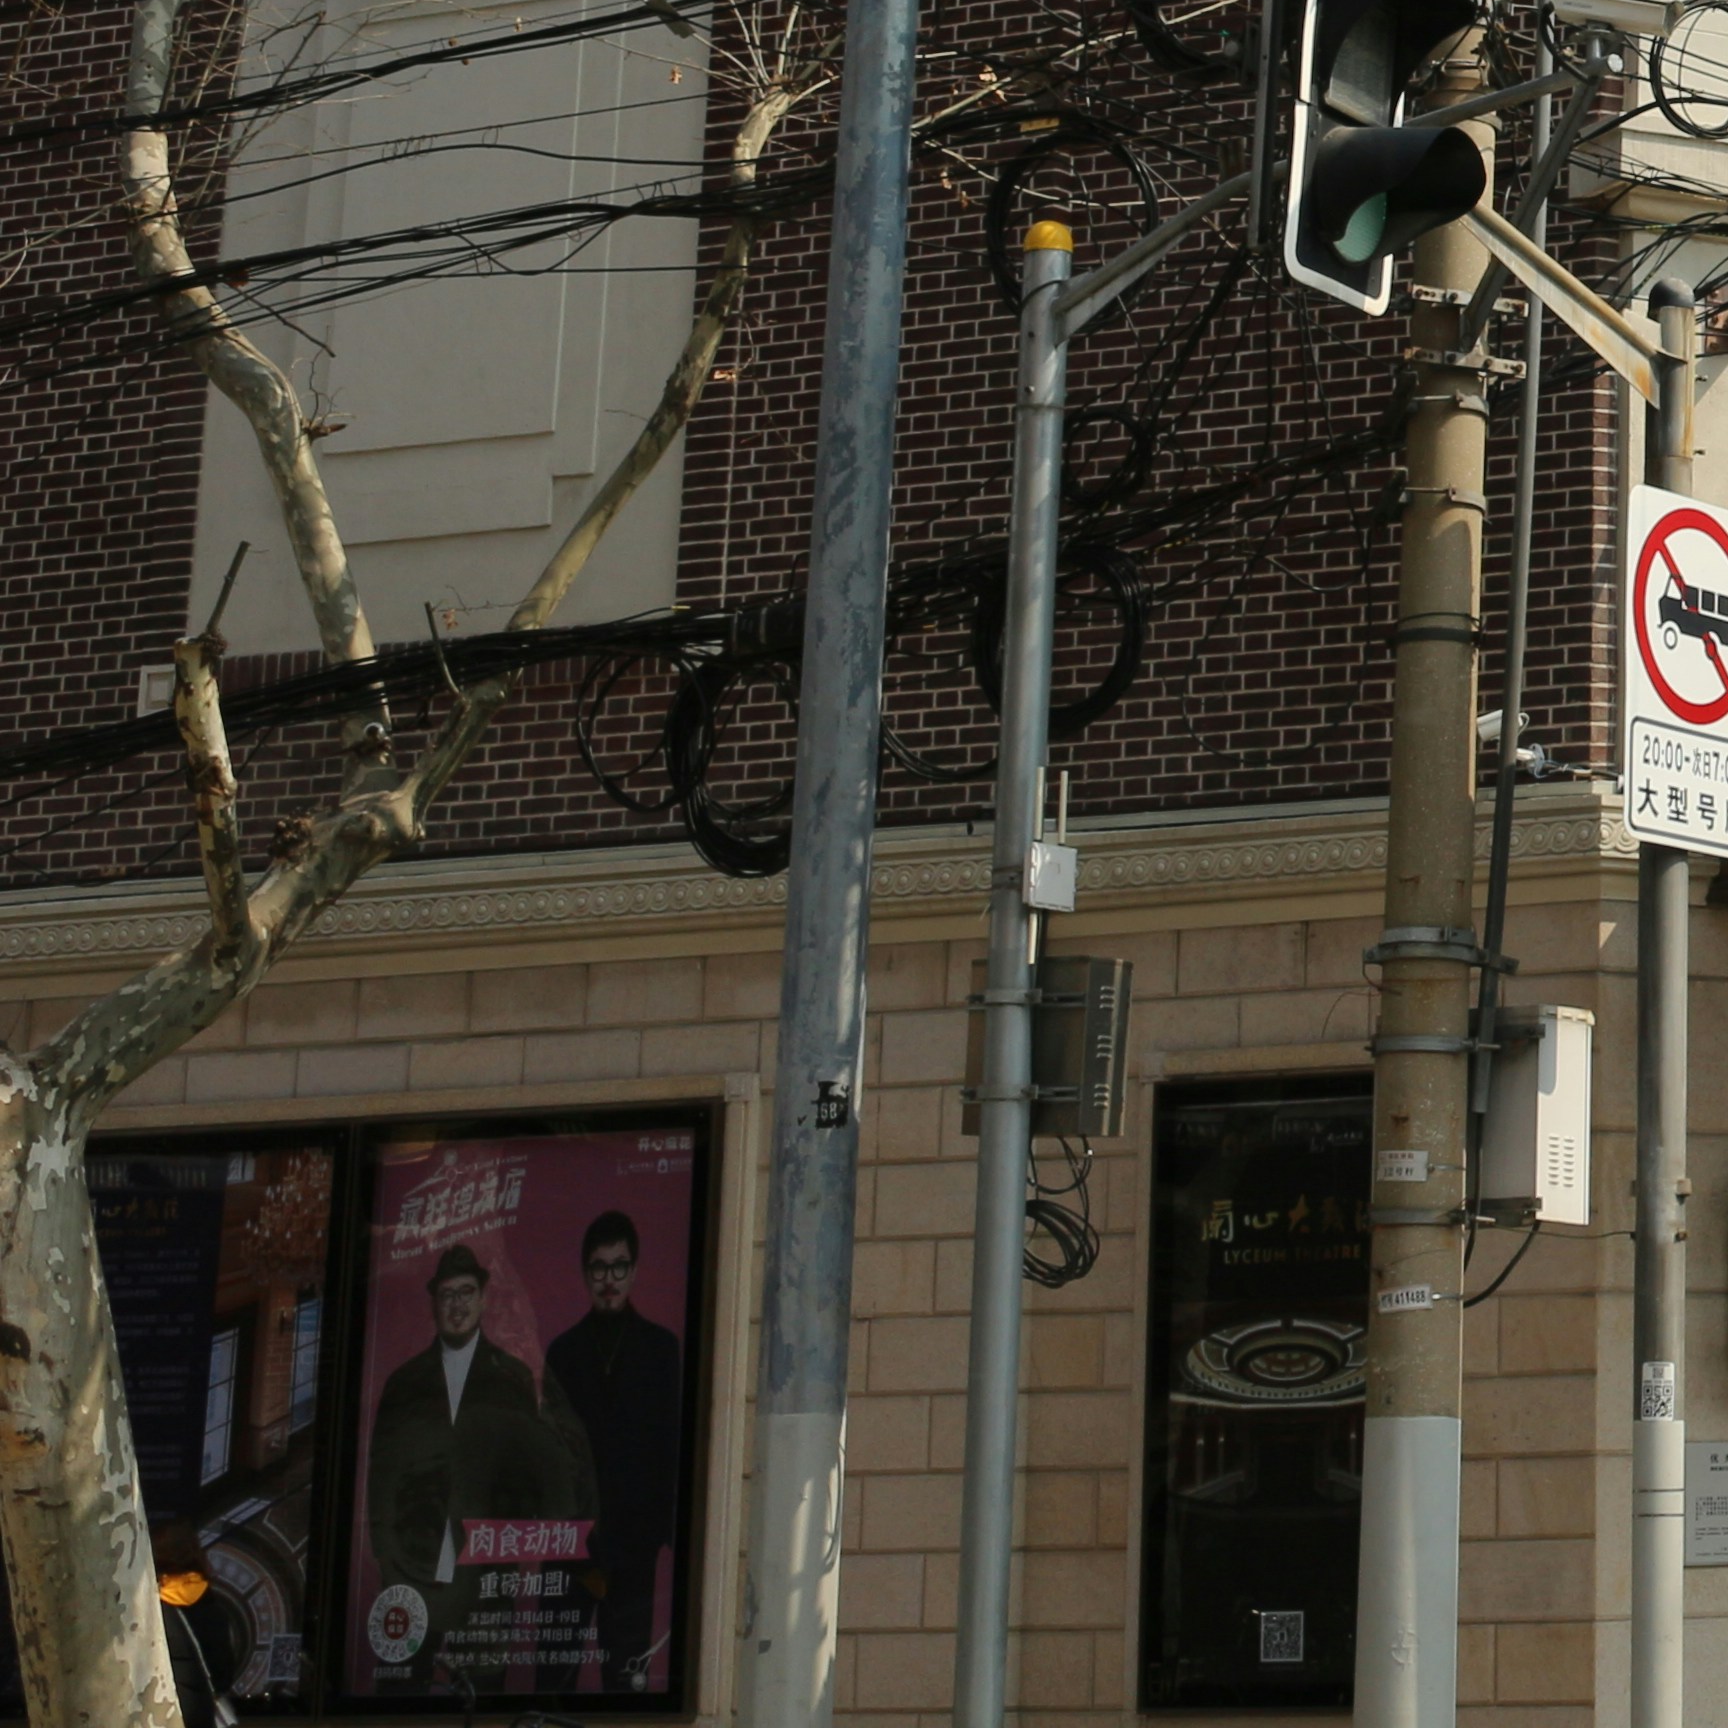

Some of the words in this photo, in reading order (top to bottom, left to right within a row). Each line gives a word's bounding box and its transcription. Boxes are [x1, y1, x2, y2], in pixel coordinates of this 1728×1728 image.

[1223, 1247, 1288, 1265] LYCEUM
[469, 1522, 578, 1558] 肉食动物
[478, 1570, 571, 1600] 重磅加盟!
